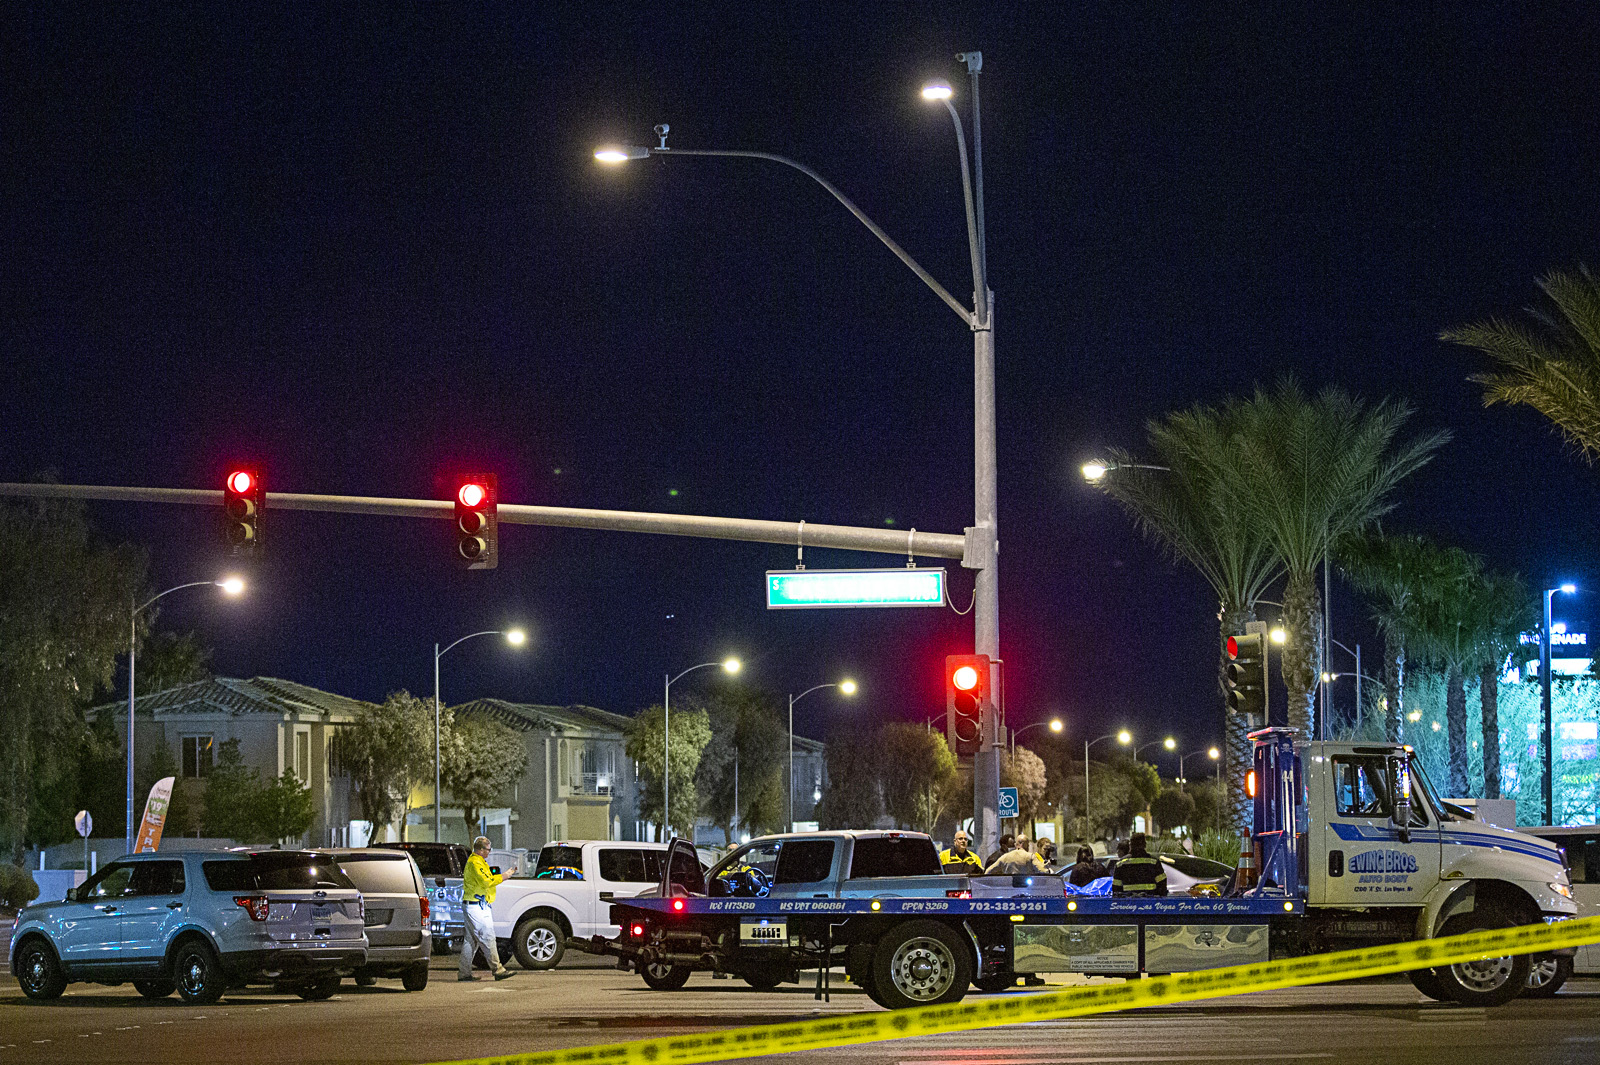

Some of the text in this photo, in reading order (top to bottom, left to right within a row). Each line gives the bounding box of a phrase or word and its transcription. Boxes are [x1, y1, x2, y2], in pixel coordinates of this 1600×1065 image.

[1348, 849, 1419, 873] EWING BROS.
[1359, 875, 1409, 883] AUTO BODY
[925, 902, 949, 910] 3269
[969, 902, 1047, 911] 702-382-9261
[1109, 902, 1137, 912] Serving
[1155, 902, 1176, 912] Vegas
[1178, 902, 1192, 911] For
[1194, 902, 1210, 911] Over
[1212, 903, 1224, 911] 60
